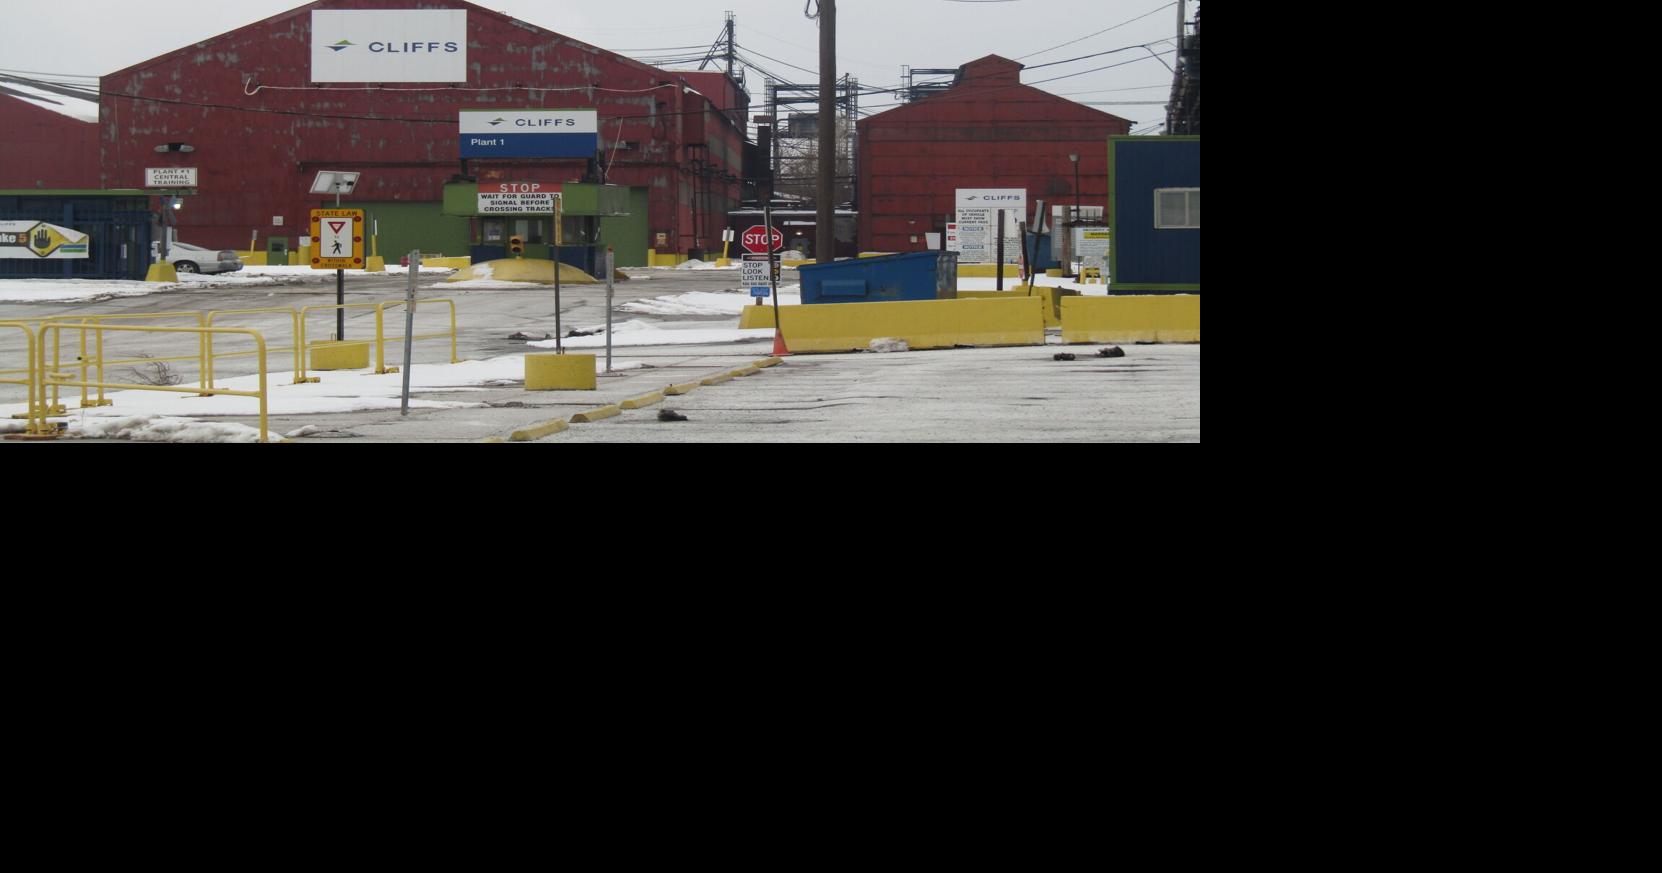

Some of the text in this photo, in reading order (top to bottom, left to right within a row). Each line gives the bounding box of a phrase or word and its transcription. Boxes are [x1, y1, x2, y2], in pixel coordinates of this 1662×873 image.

[368, 41, 458, 53] CLIFFS
[515, 118, 575, 126] CLIFFS
[471, 138, 505, 146] Plant 1
[500, 183, 541, 193] STOP
[0, 233, 27, 244] ke 5
[744, 234, 780, 245] STOP
